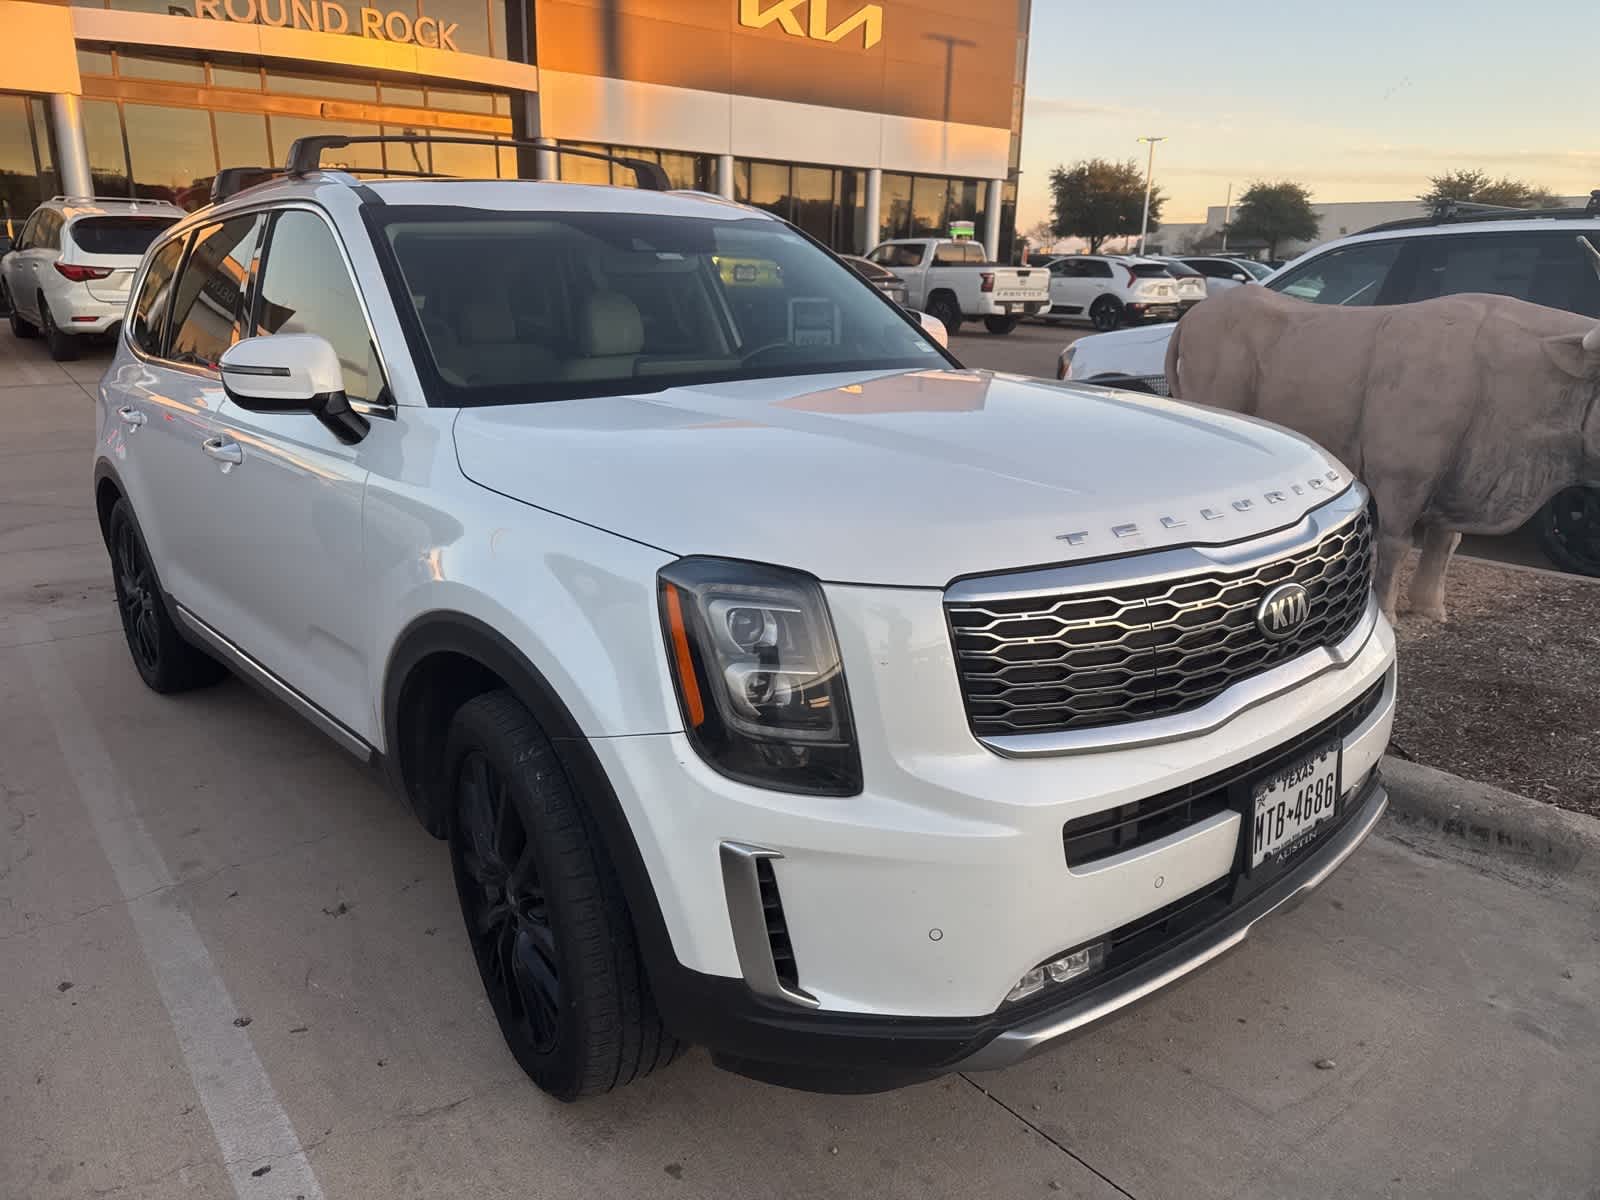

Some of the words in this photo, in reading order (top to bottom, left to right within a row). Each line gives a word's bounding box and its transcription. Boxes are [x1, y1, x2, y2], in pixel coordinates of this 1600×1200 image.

[194, 0, 349, 34] ROUND
[360, 7, 459, 50] ROCK
[1055, 470, 1340, 546] TELLURIDE
[1270, 591, 1308, 630] KIA
[1281, 763, 1315, 792] TEXAS
